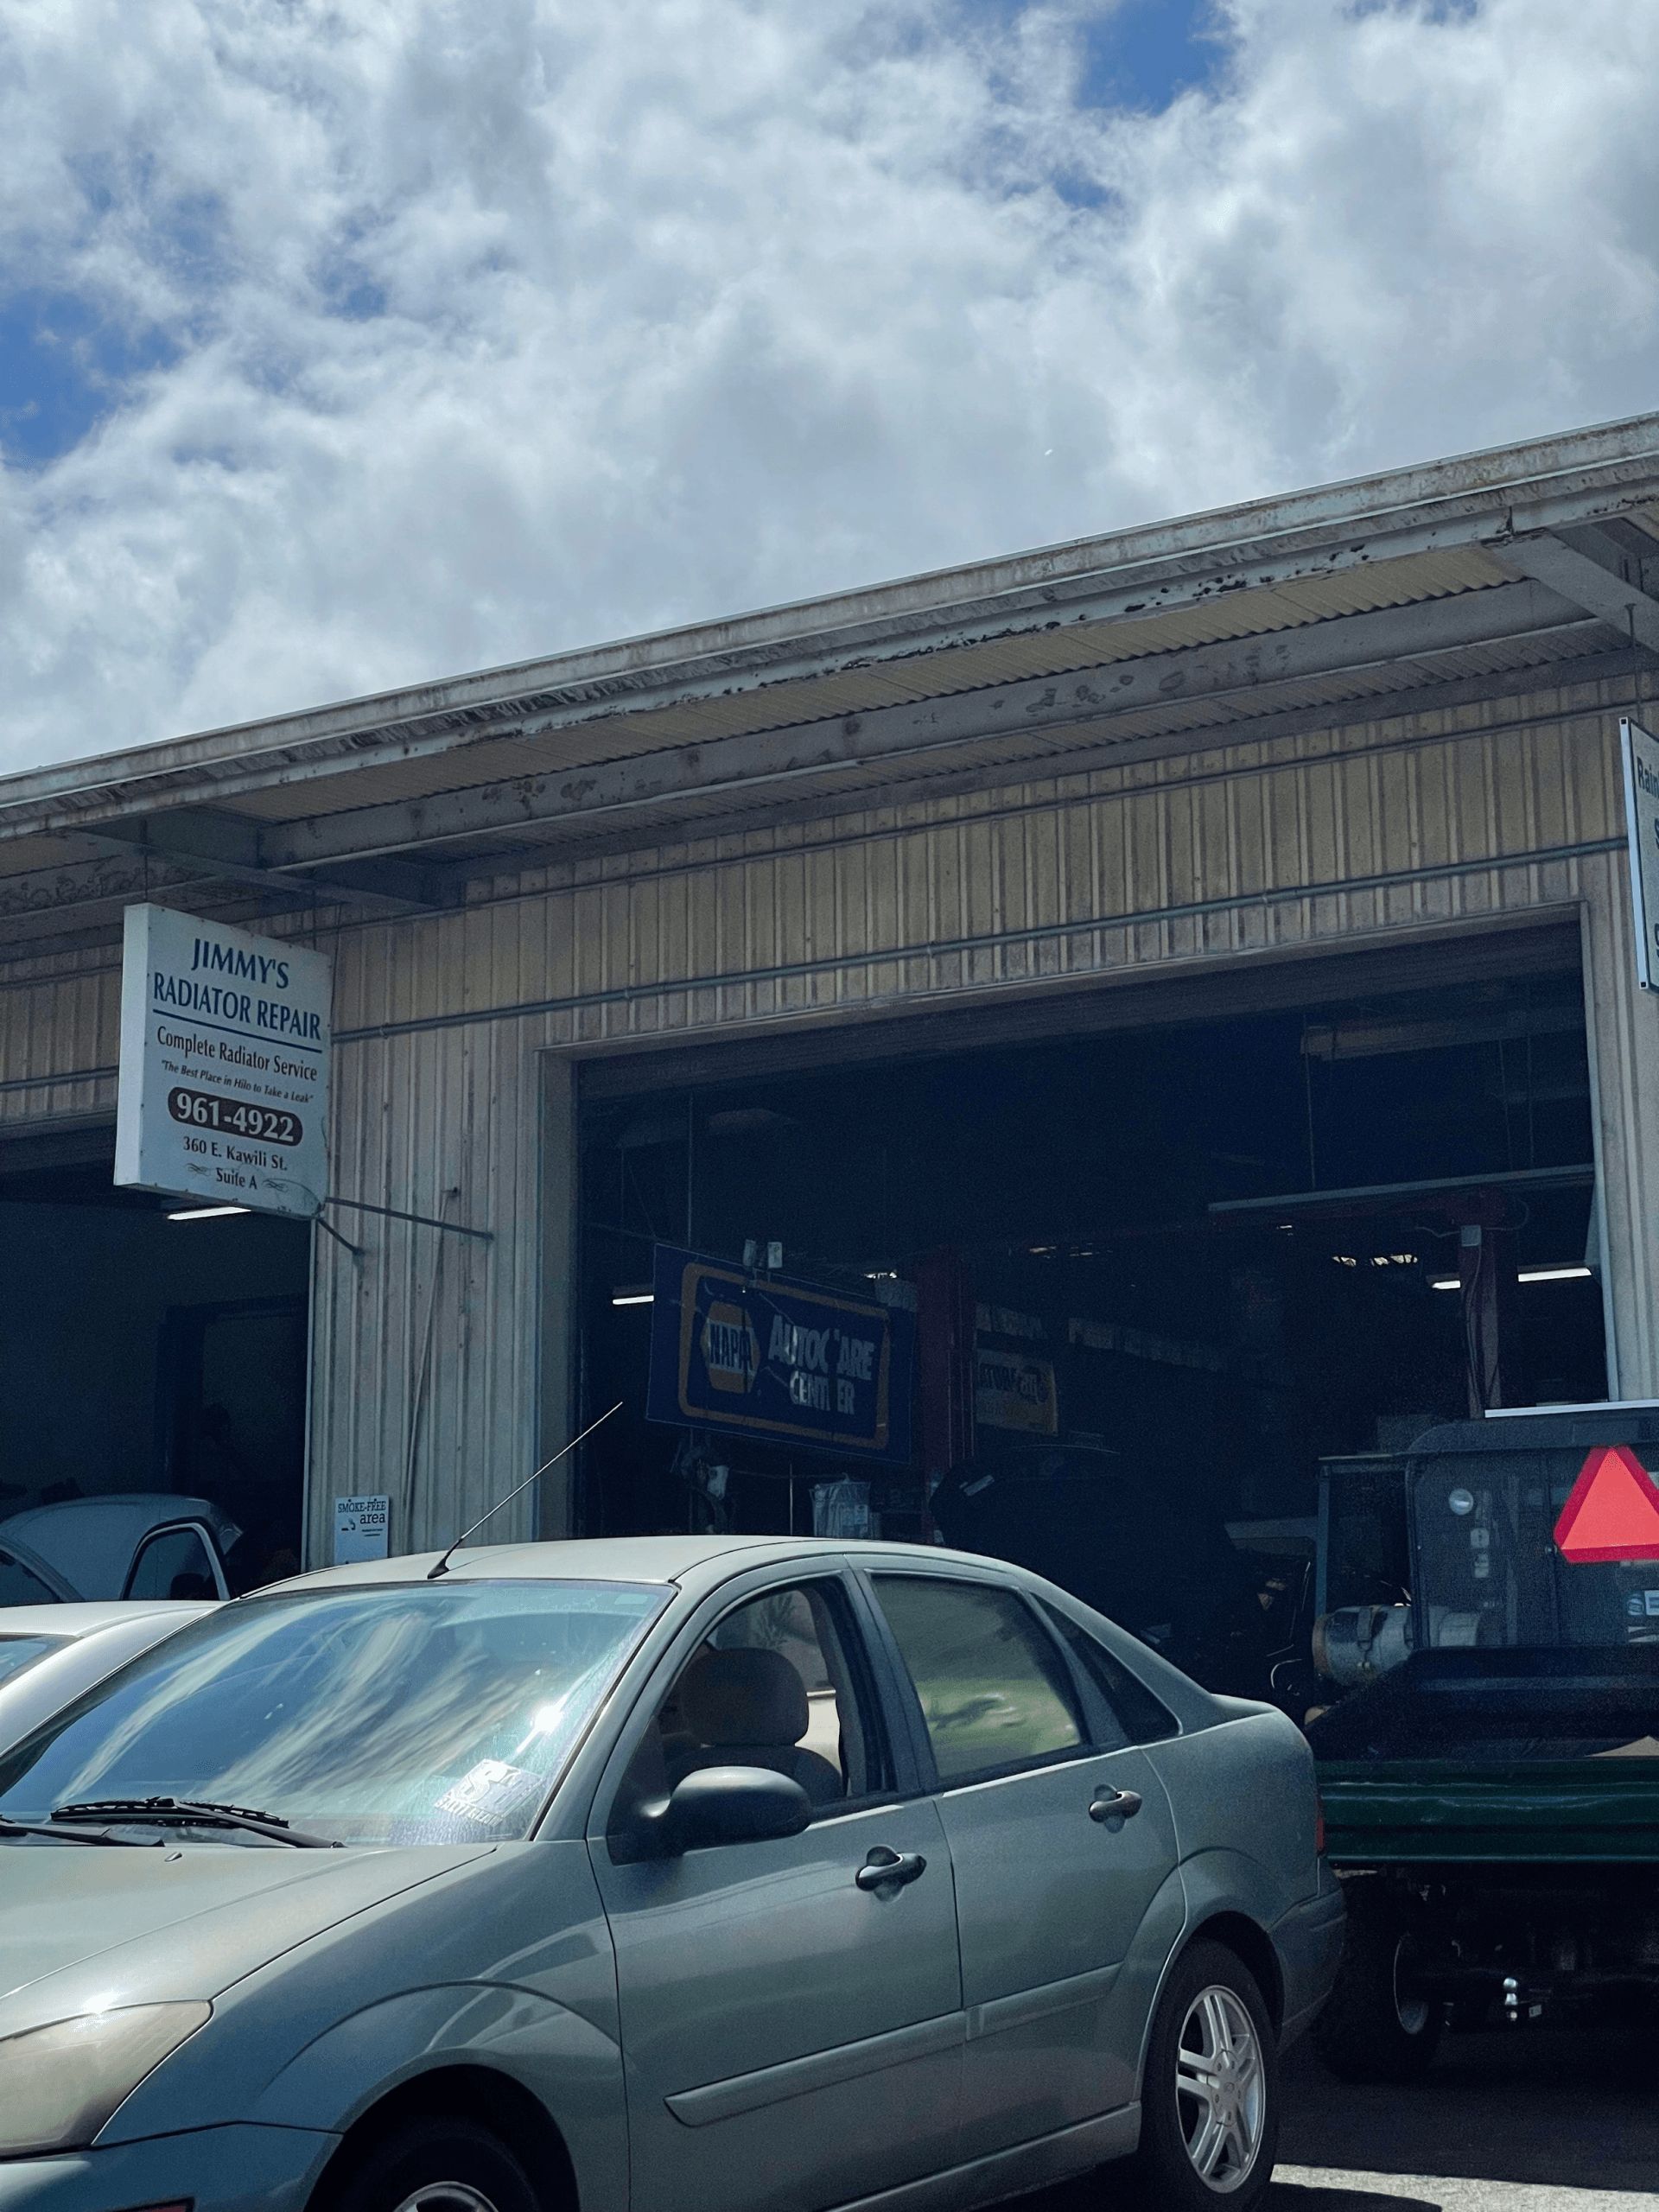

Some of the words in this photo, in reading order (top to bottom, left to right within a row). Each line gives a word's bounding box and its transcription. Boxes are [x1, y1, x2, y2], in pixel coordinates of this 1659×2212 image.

[191, 938, 289, 989] JIMMY'S
[154, 972, 251, 1024] RADIATOR
[257, 1000, 321, 1040] REPAIR
[157, 1026, 215, 1058] Complete
[219, 1042, 270, 1071] Radiator
[274, 1055, 318, 1081] Service
[181, 1065, 199, 1077] Best
[200, 1070, 221, 1084] Place
[224, 1074, 232, 1085] in
[234, 1077, 251, 1090] Hilo
[253, 1082, 262, 1093] to
[264, 1085, 282, 1098] Take
[283, 1090, 289, 1099] a
[176, 1092, 295, 1142] 961-4922
[183, 1136, 207, 1154] 360
[212, 1142, 222, 1158] E.
[226, 1146, 267, 1166] Kawili
[270, 1154, 288, 1171] St.
[216, 1167, 245, 1186] Suite
[249, 1175, 258, 1190] A
[710, 1326, 753, 1370] NAPA
[790, 1370, 855, 1415] CENTER
[338, 1501, 387, 1513] SMOKE-FREE
[359, 1513, 385, 1524] area
